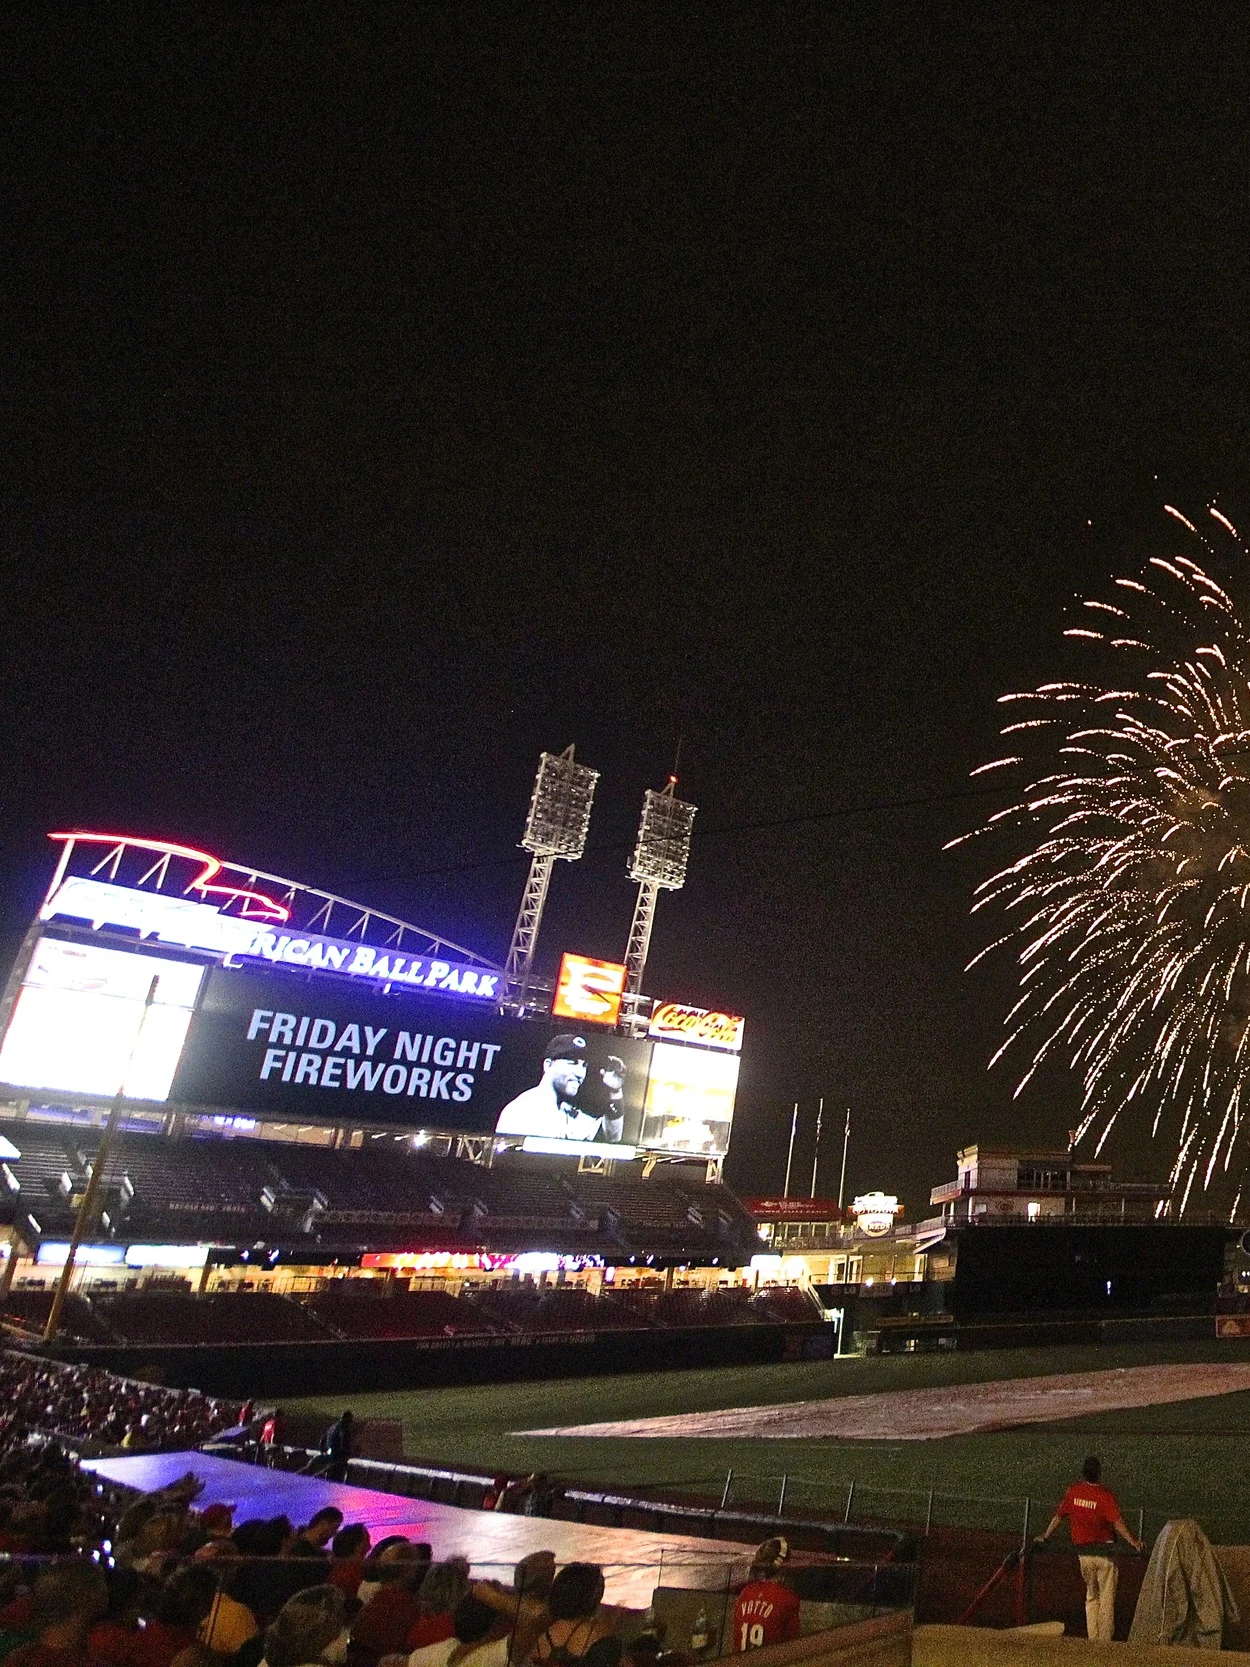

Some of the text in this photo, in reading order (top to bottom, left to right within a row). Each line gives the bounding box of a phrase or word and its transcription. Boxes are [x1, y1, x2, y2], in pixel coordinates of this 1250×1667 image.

[348, 946, 425, 985] BALL
[423, 961, 499, 997] PARK
[247, 1009, 501, 1071] FRIDAY NIGHT
[259, 1049, 475, 1102] FIREWORKS
[1073, 1498, 1098, 1509] SECURITY
[741, 1600, 774, 1618] VOTTO
[740, 1622, 764, 1651] 19
